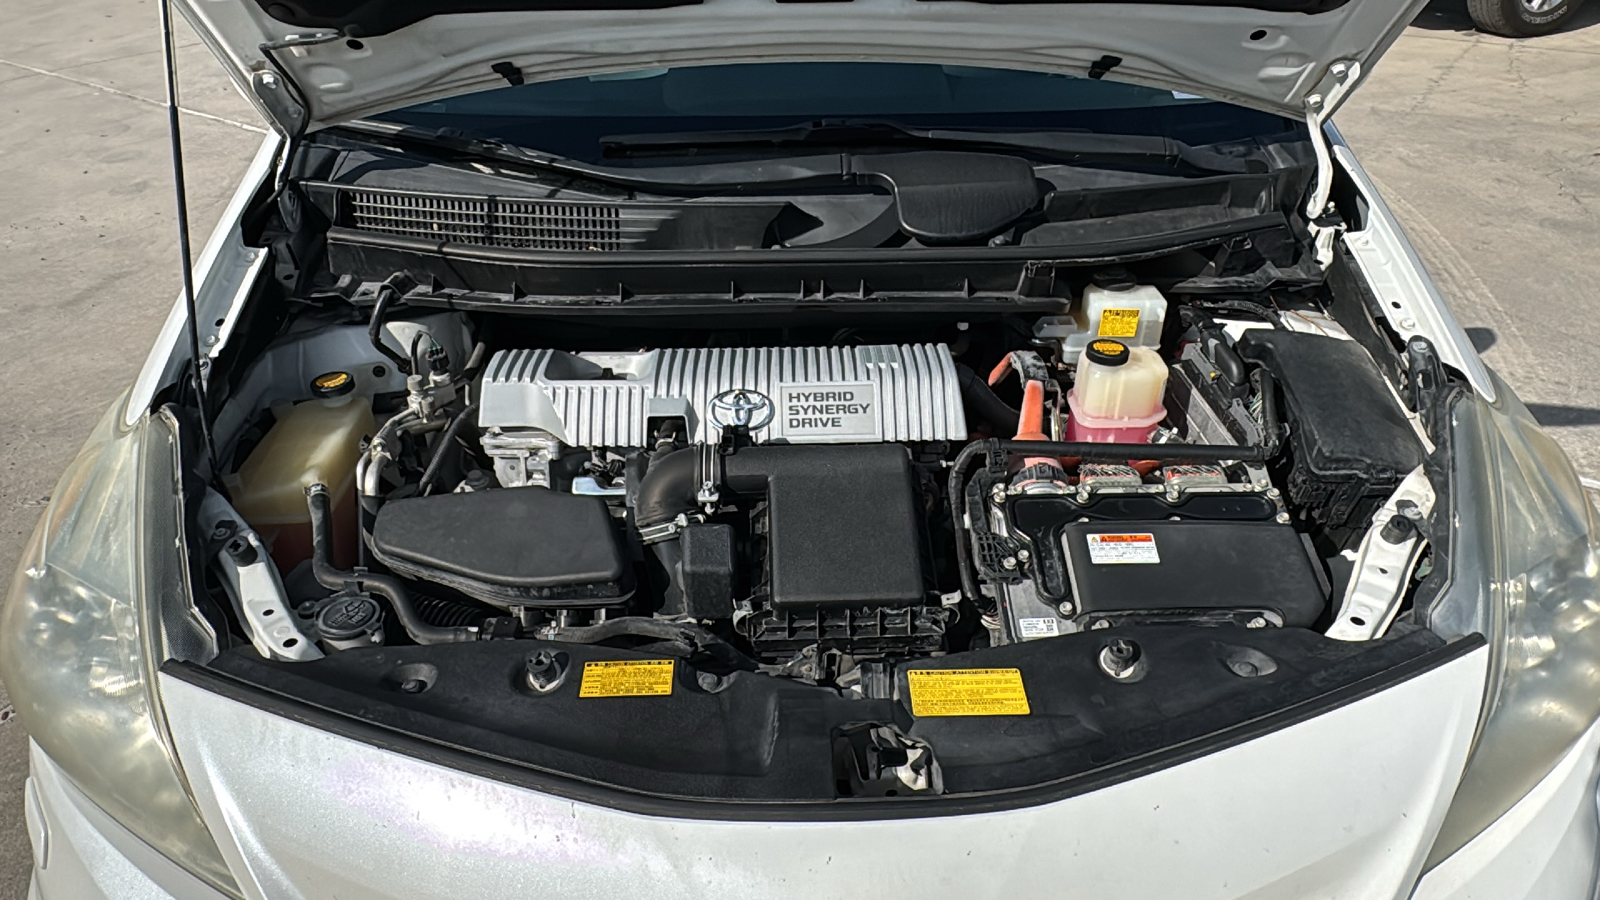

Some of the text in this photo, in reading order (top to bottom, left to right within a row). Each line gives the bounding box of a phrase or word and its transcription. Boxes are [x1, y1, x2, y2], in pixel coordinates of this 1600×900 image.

[788, 391, 854, 403] HYBRID
[788, 403, 871, 415] SYNERGY
[788, 417, 842, 428] DRIVE
